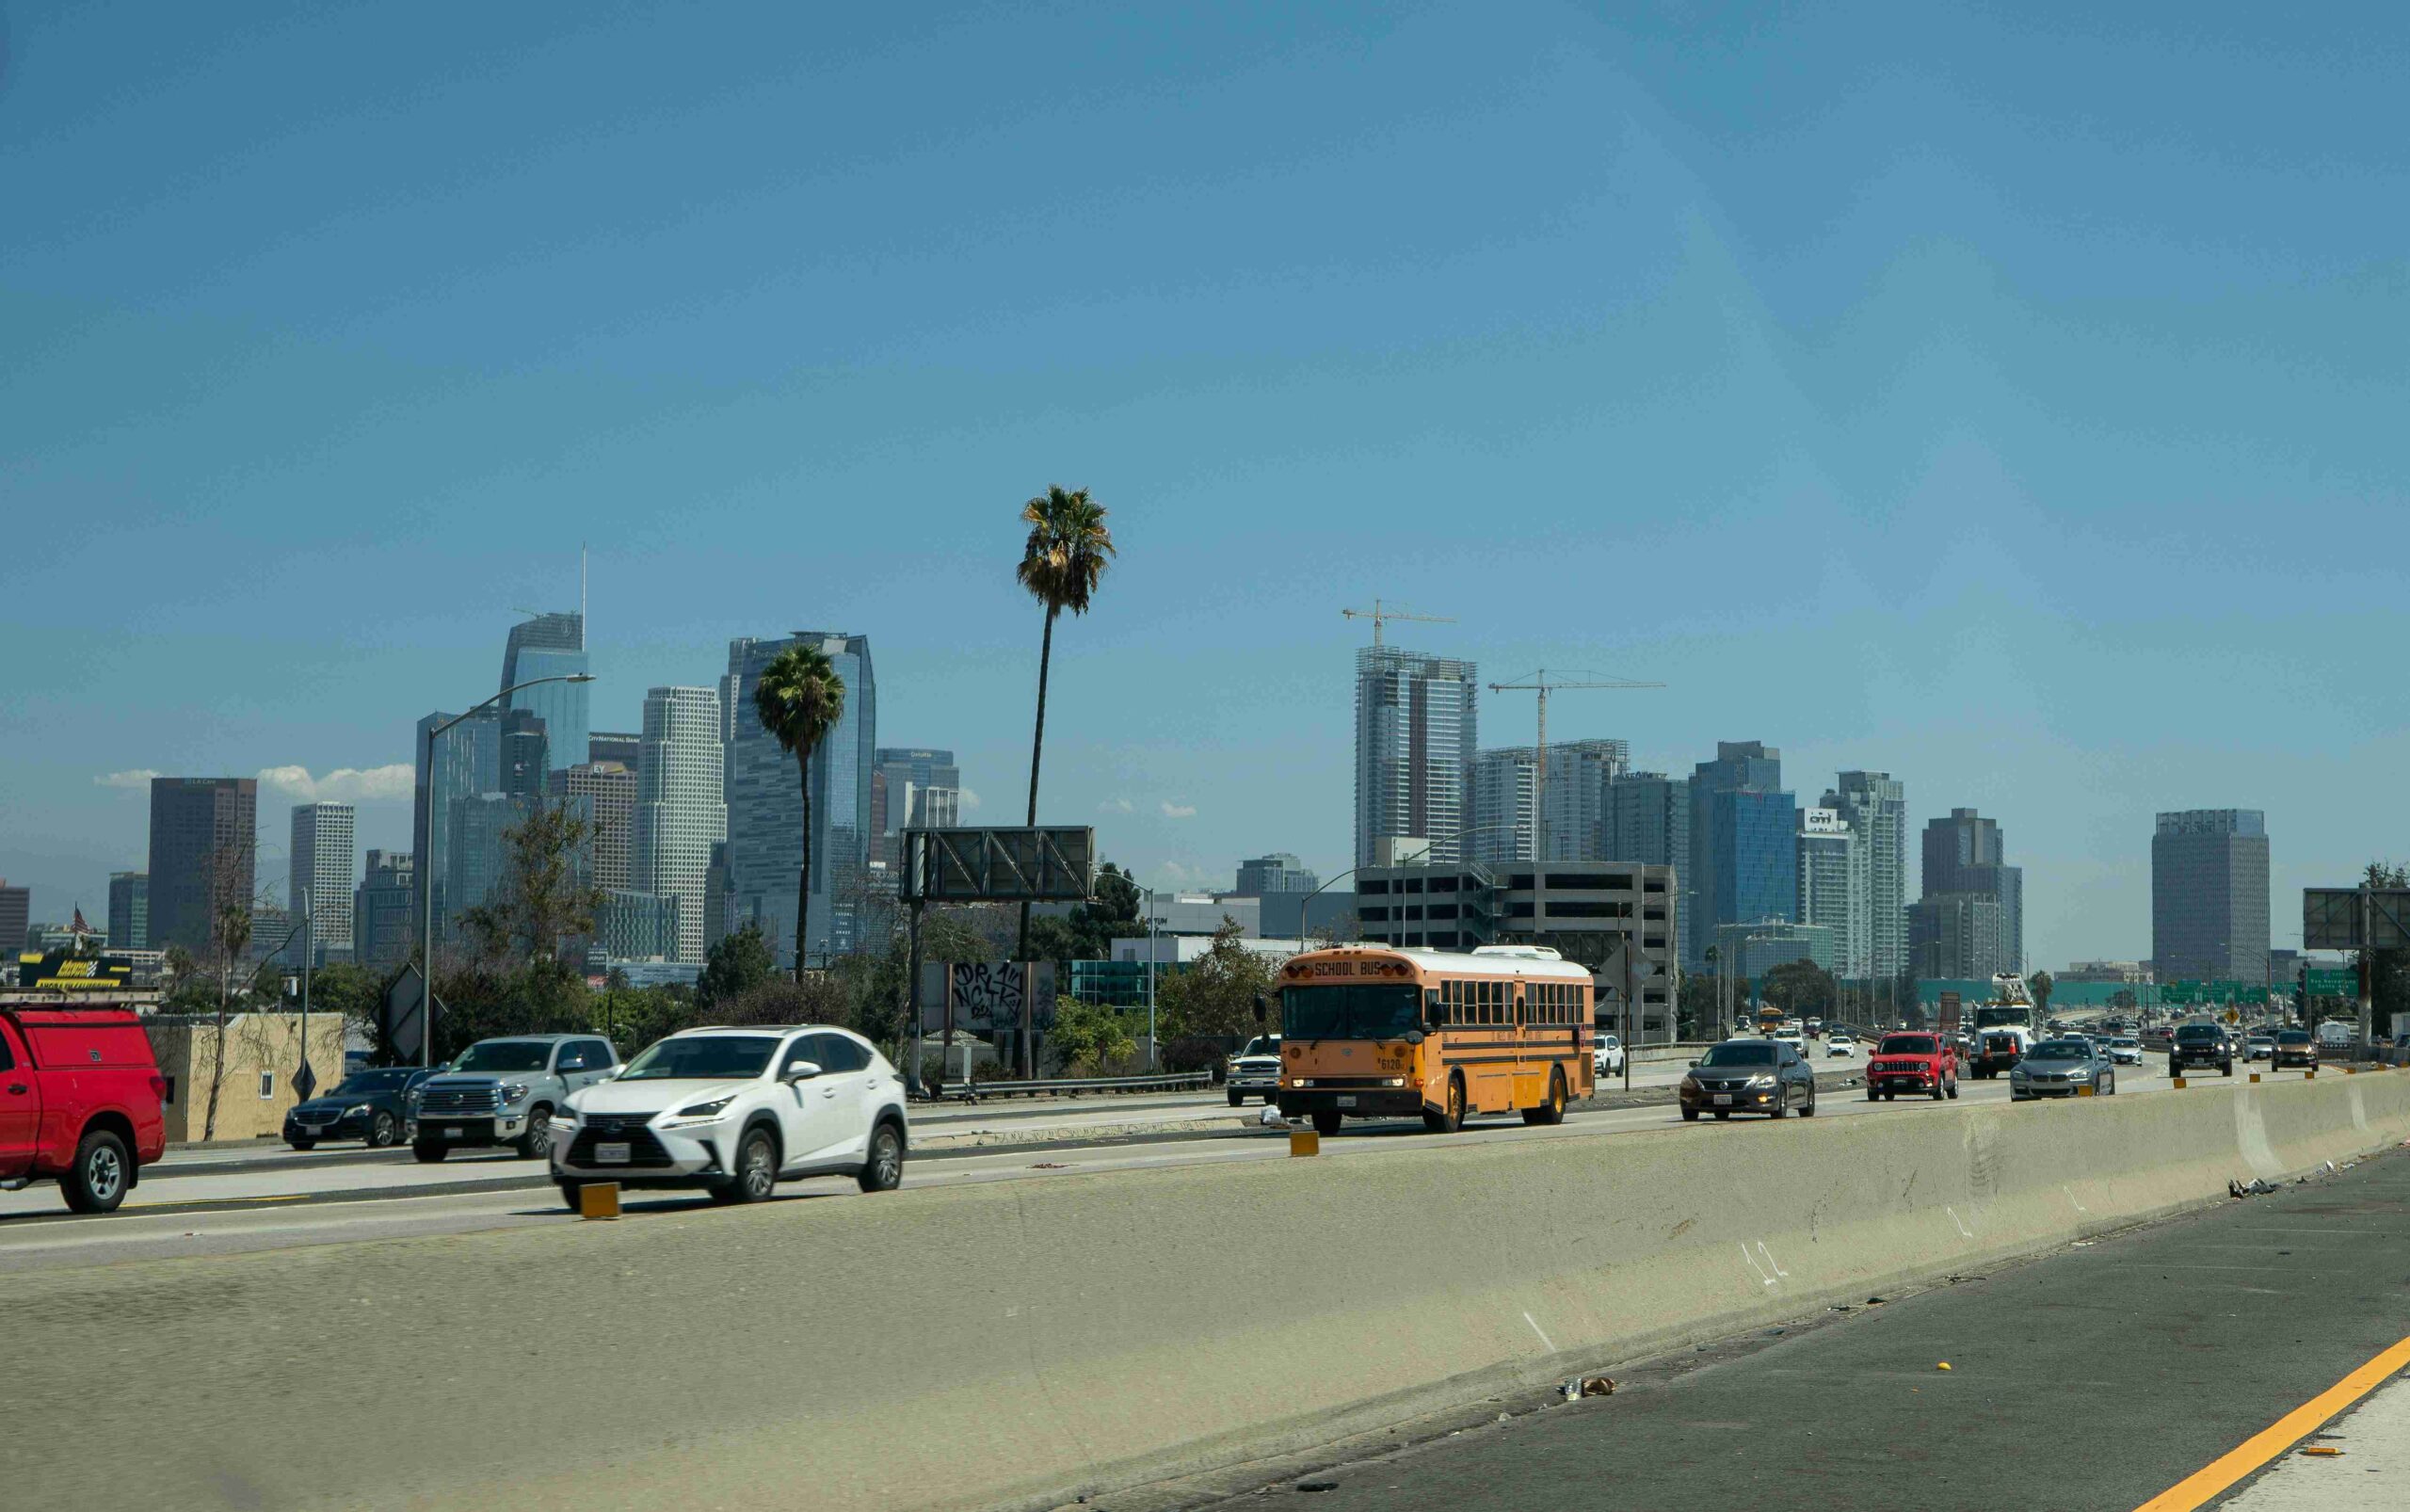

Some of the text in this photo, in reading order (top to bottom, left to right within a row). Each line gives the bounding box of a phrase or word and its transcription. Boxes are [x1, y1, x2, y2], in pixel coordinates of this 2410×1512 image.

[593, 764, 604, 774] EY
[1315, 961, 1381, 976] SCHOOL BUS
[1381, 1058, 1401, 1070] 6120
